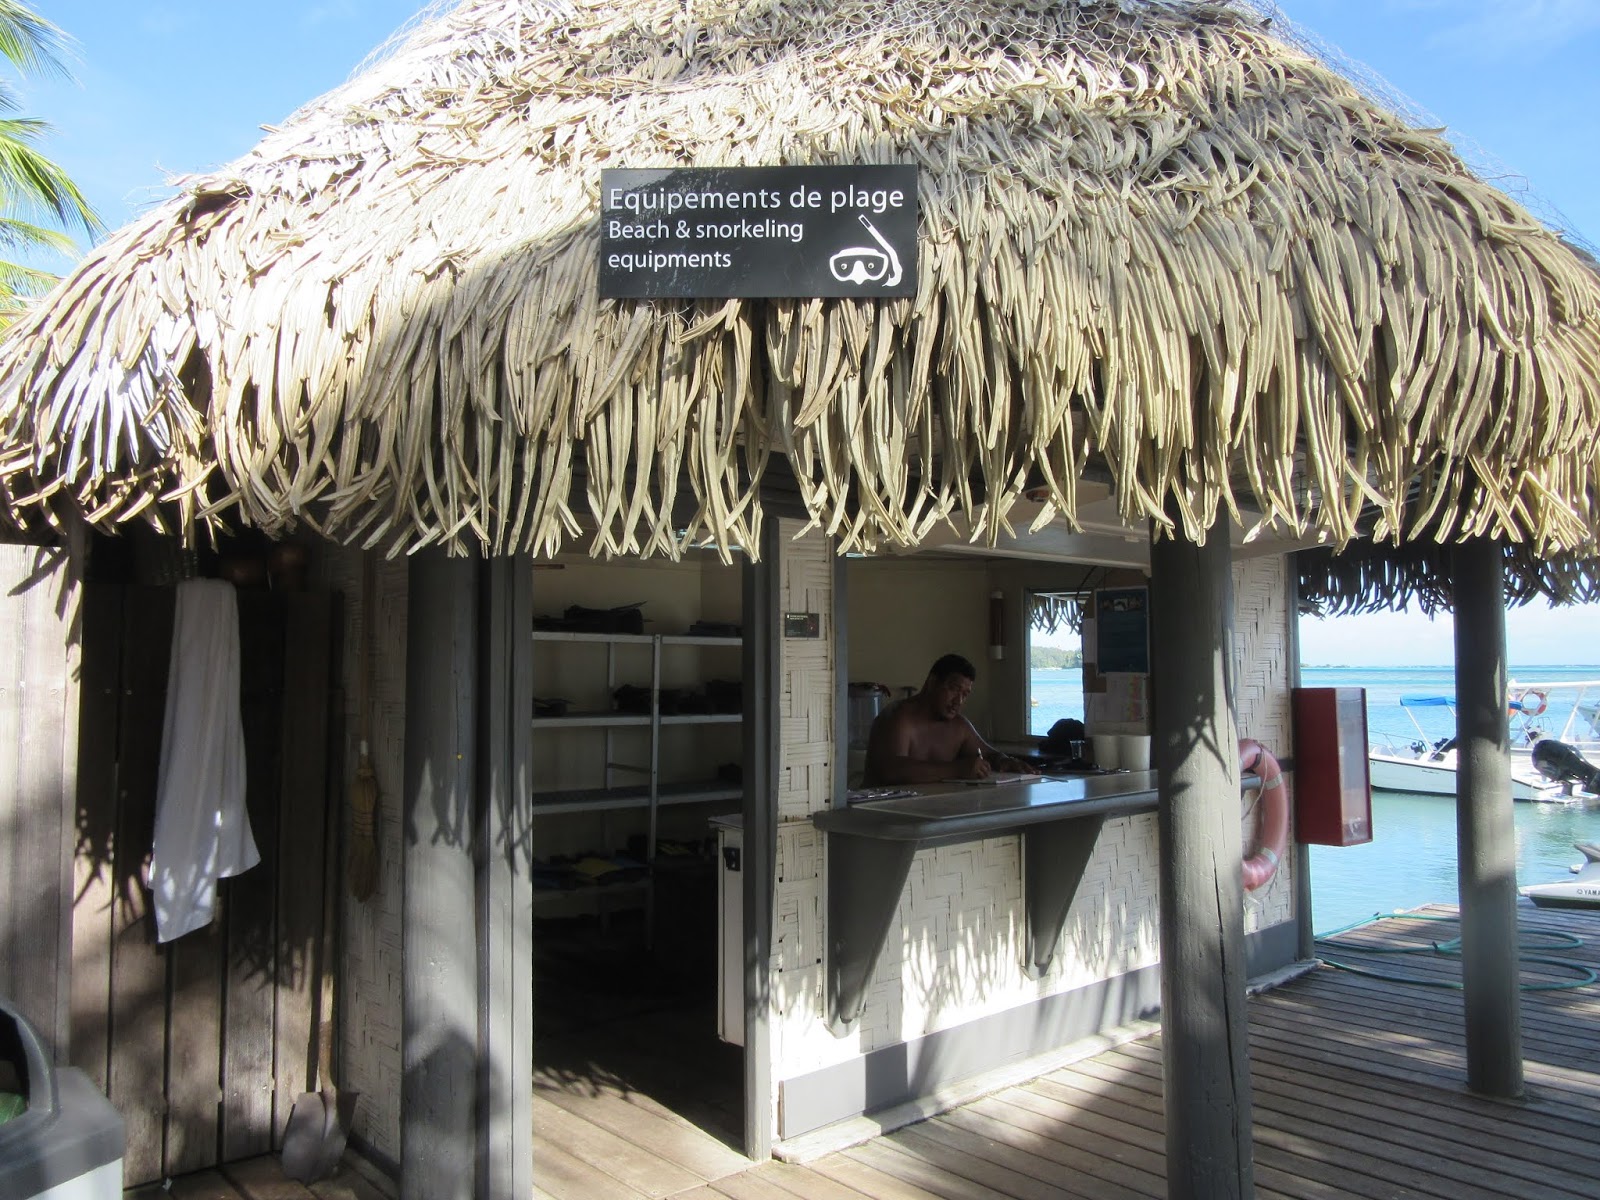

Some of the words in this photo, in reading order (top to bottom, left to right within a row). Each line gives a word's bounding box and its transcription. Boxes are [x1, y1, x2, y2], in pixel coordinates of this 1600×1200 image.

[609, 188, 781, 214] Equipements
[789, 185, 822, 209] de
[830, 185, 904, 214] plage
[608, 220, 670, 239] Beach
[675, 221, 691, 239] &
[696, 219, 804, 242] snorkeling
[607, 251, 732, 272] equipments
